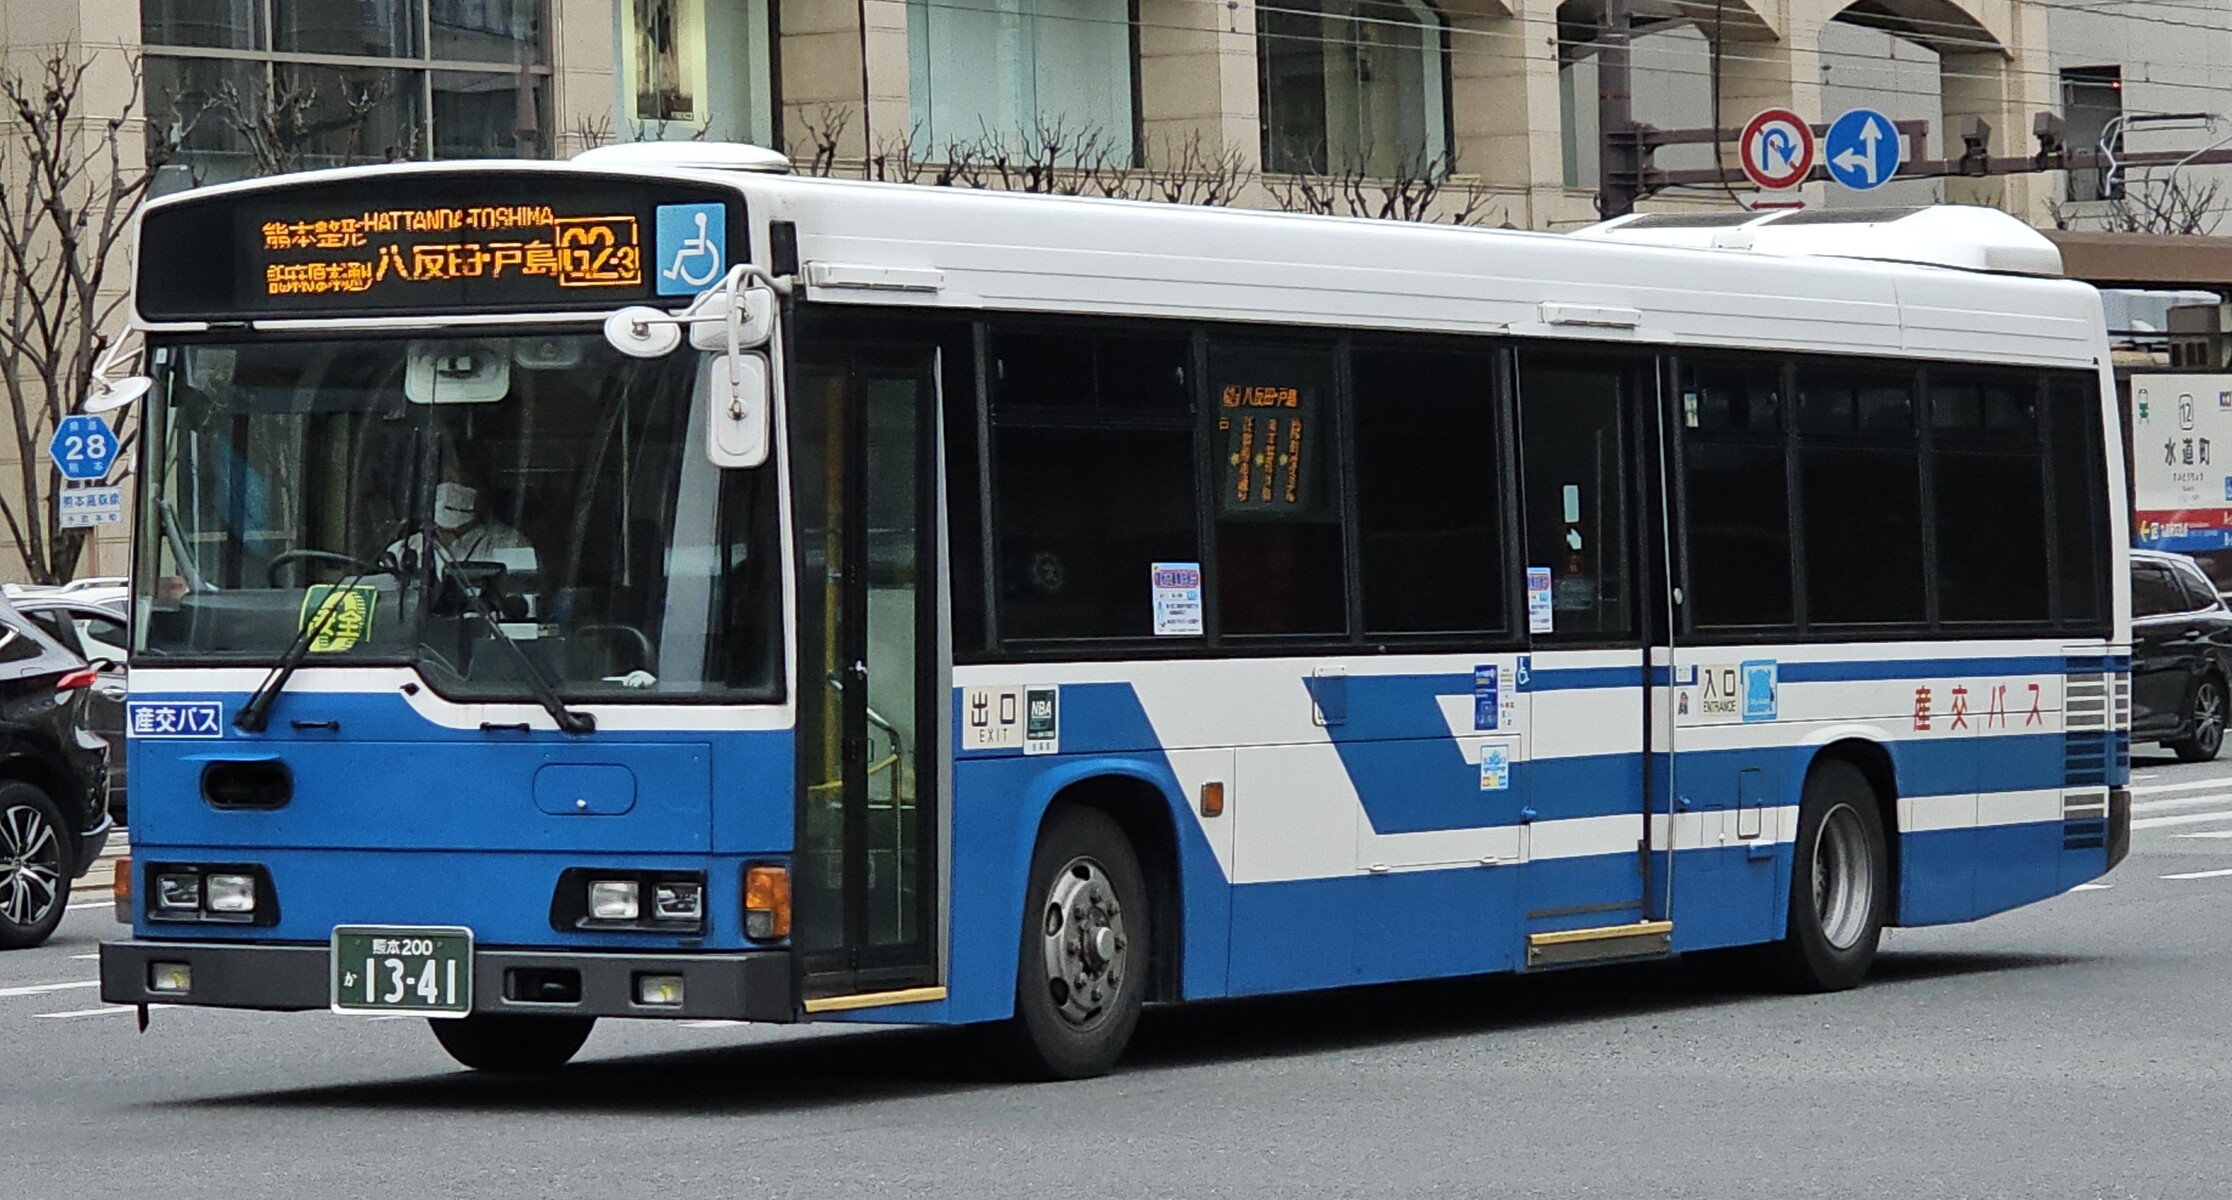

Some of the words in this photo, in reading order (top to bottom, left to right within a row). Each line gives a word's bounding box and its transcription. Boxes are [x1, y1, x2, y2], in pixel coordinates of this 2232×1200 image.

[65, 434, 106, 460] 28
[2164, 437, 2211, 466] 水道町
[1704, 669, 1736, 698] 入口
[134, 706, 218, 733] 産交バス
[971, 691, 1016, 727] 出口
[1031, 700, 1052, 717] NBA
[1703, 700, 1736, 713] ENTRANCE
[1914, 684, 2043, 732] 産交バス
[979, 728, 1008, 743] EXIT
[343, 971, 358, 988] か
[366, 958, 456, 1004] 13-41
